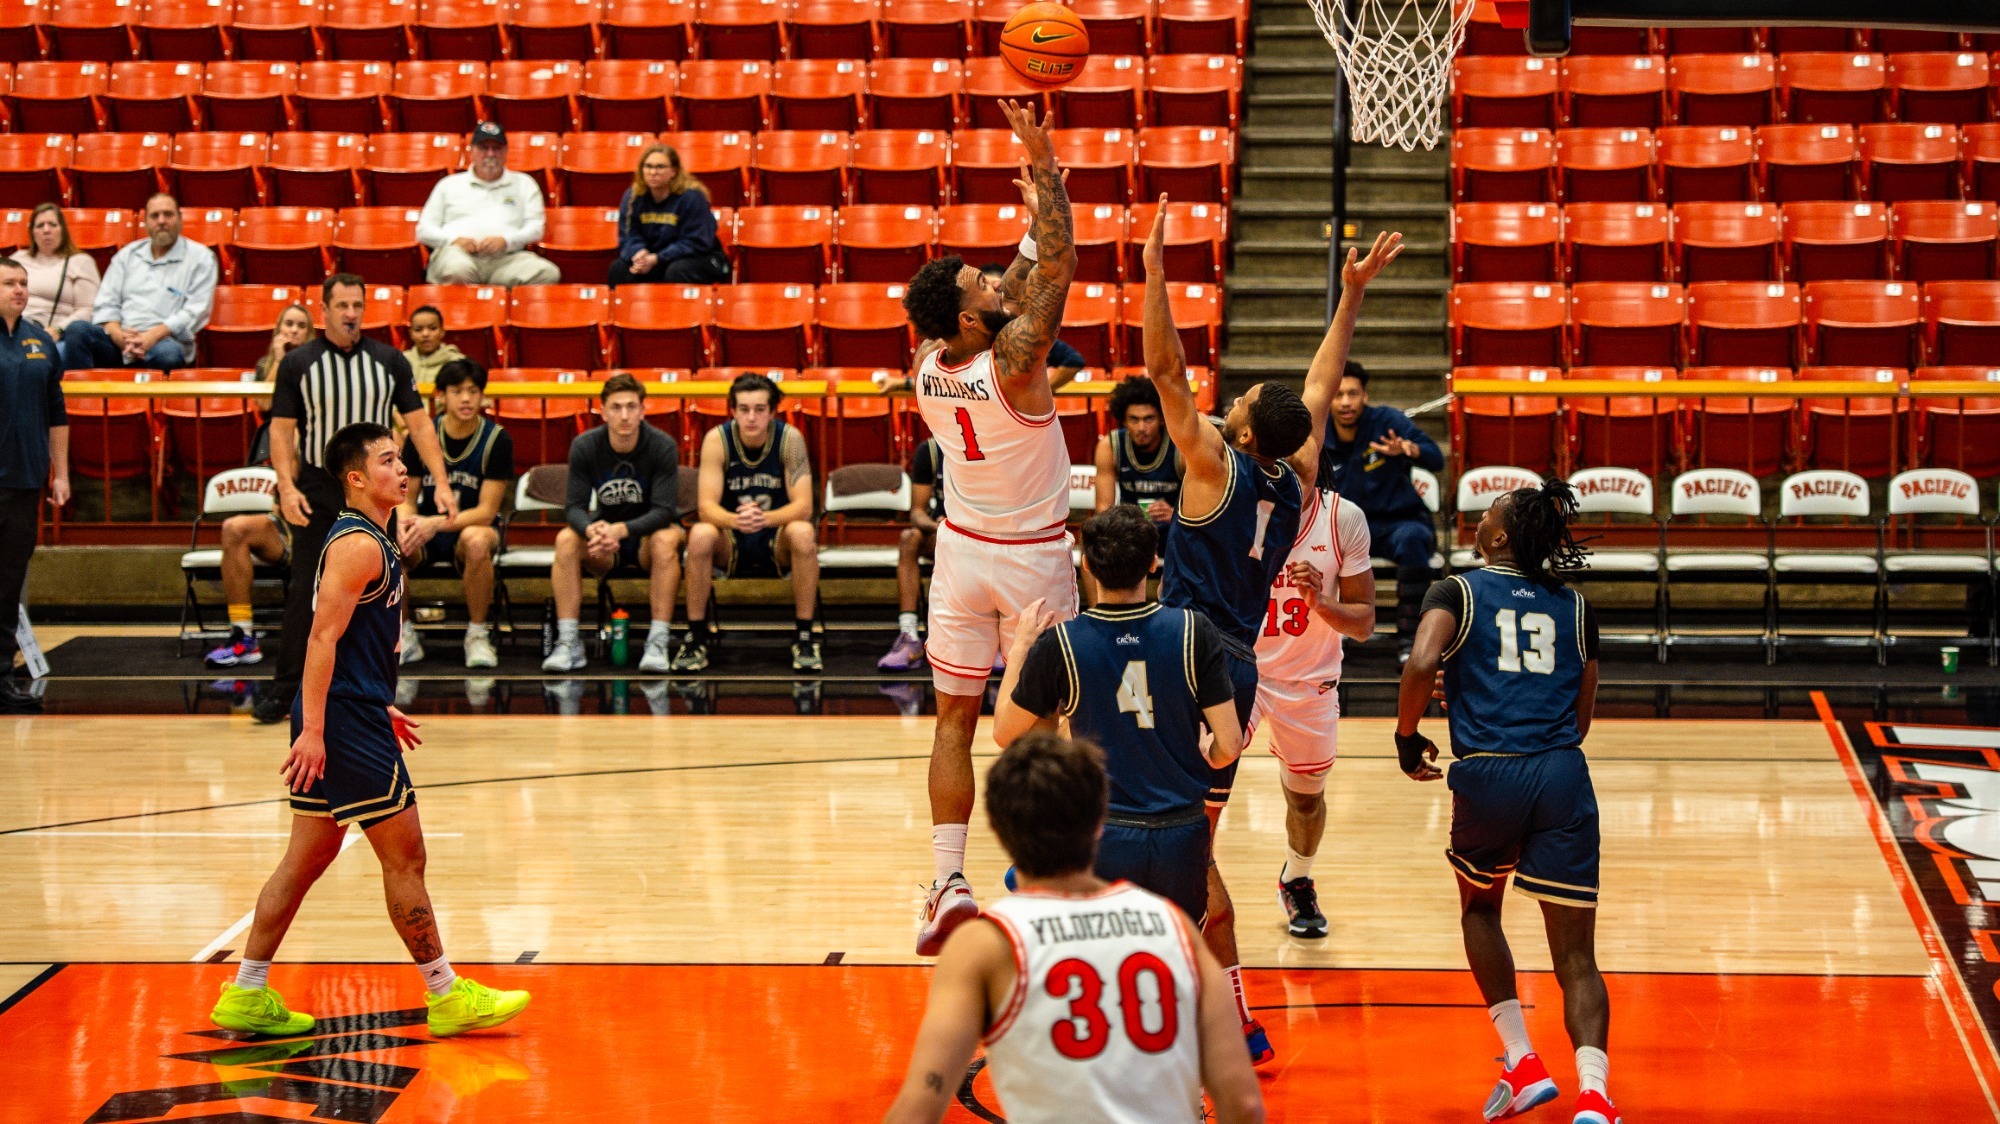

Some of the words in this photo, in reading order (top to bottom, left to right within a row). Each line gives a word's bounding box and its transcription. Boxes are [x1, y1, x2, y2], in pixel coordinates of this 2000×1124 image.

[1027, 58, 1074, 75] ELITE
[922, 373, 990, 401] WILLIAMS
[954, 406, 986, 461] 1
[1577, 477, 1645, 497] PACIFIC
[1682, 478, 1752, 499] PACIFIC
[1791, 479, 1861, 500] PACIFIC
[1900, 478, 1971, 499] PACIFIC
[1248, 500, 1275, 561] 1
[1264, 598, 1310, 637] 13
[1495, 608, 1556, 674] 13
[1116, 660, 1155, 728] 4
[1044, 951, 1180, 1061] 30
